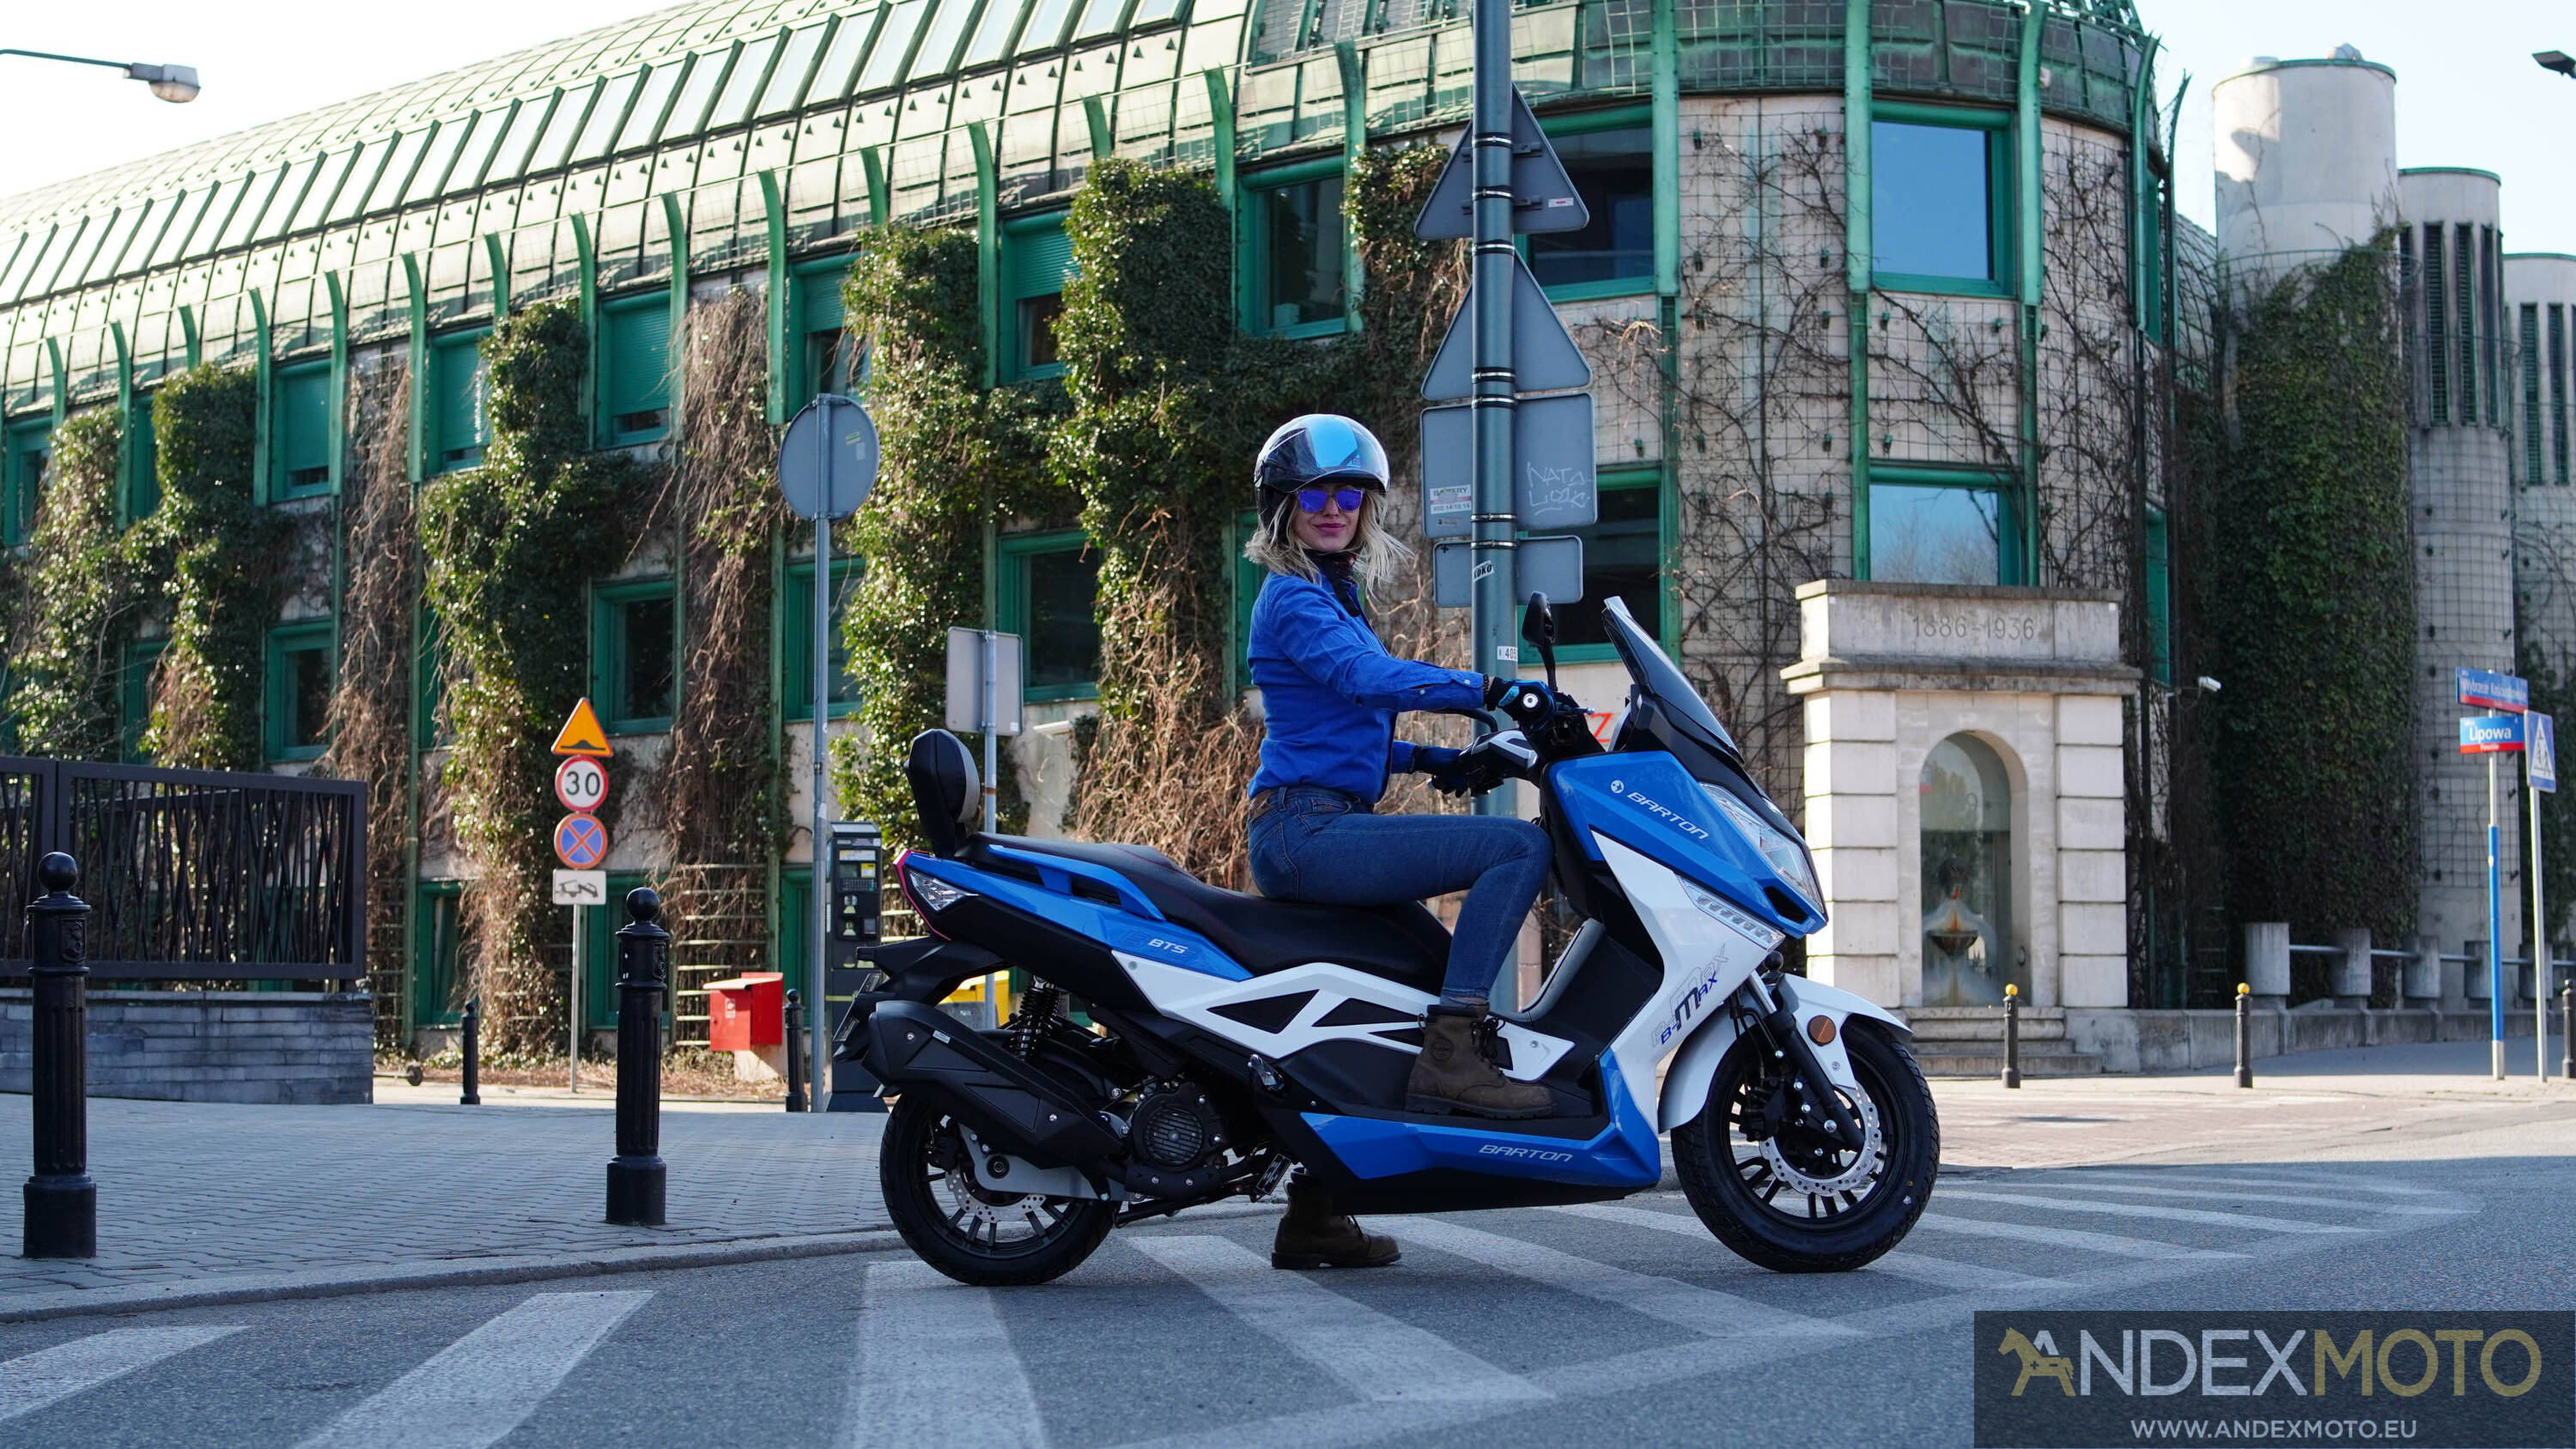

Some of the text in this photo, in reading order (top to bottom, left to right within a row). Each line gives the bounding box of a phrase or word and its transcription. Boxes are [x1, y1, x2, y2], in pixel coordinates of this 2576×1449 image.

[2470, 726, 2512, 743] Lipowa
[565, 771, 600, 797] 30
[1626, 791, 1709, 840] BARTON
[1148, 938, 1188, 954] BTS
[1479, 1144, 1573, 1162] BARTON
